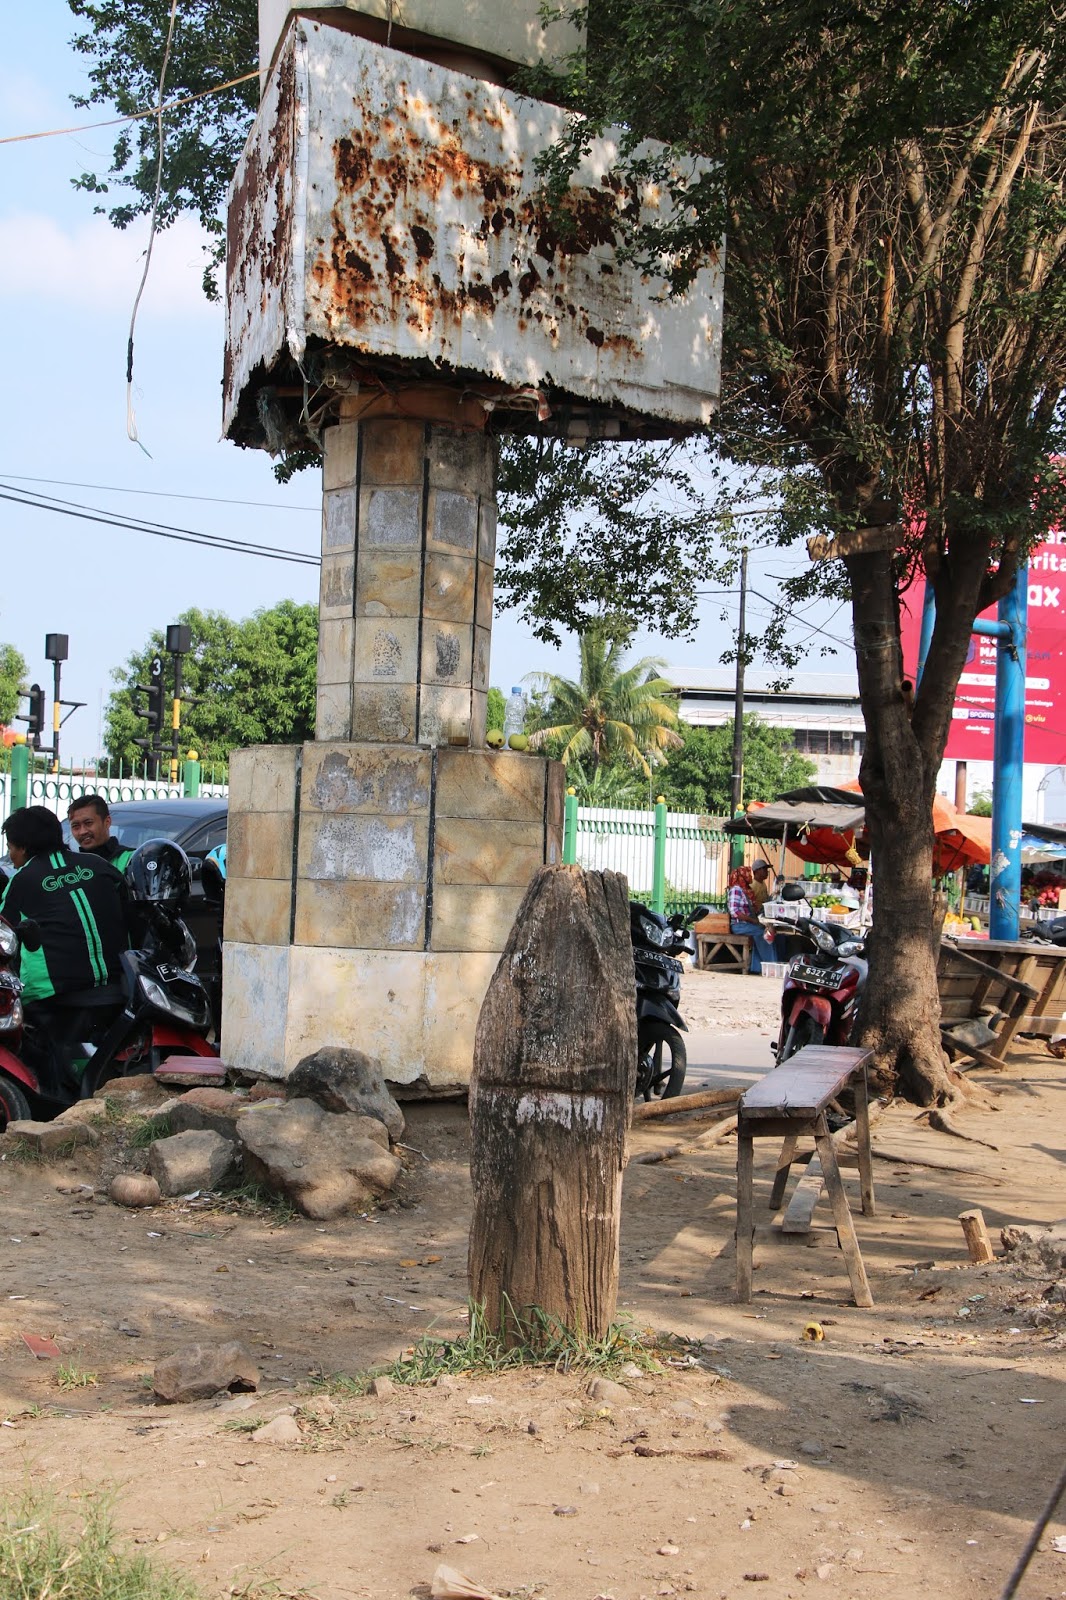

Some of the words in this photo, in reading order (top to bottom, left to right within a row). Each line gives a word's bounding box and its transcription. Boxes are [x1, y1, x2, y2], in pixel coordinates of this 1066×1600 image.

[153, 658, 161, 675] 3
[42, 865, 94, 892] Grab
[160, 965, 169, 975] E
[805, 967, 827, 977] 6327
[830, 972, 842, 981] RV
